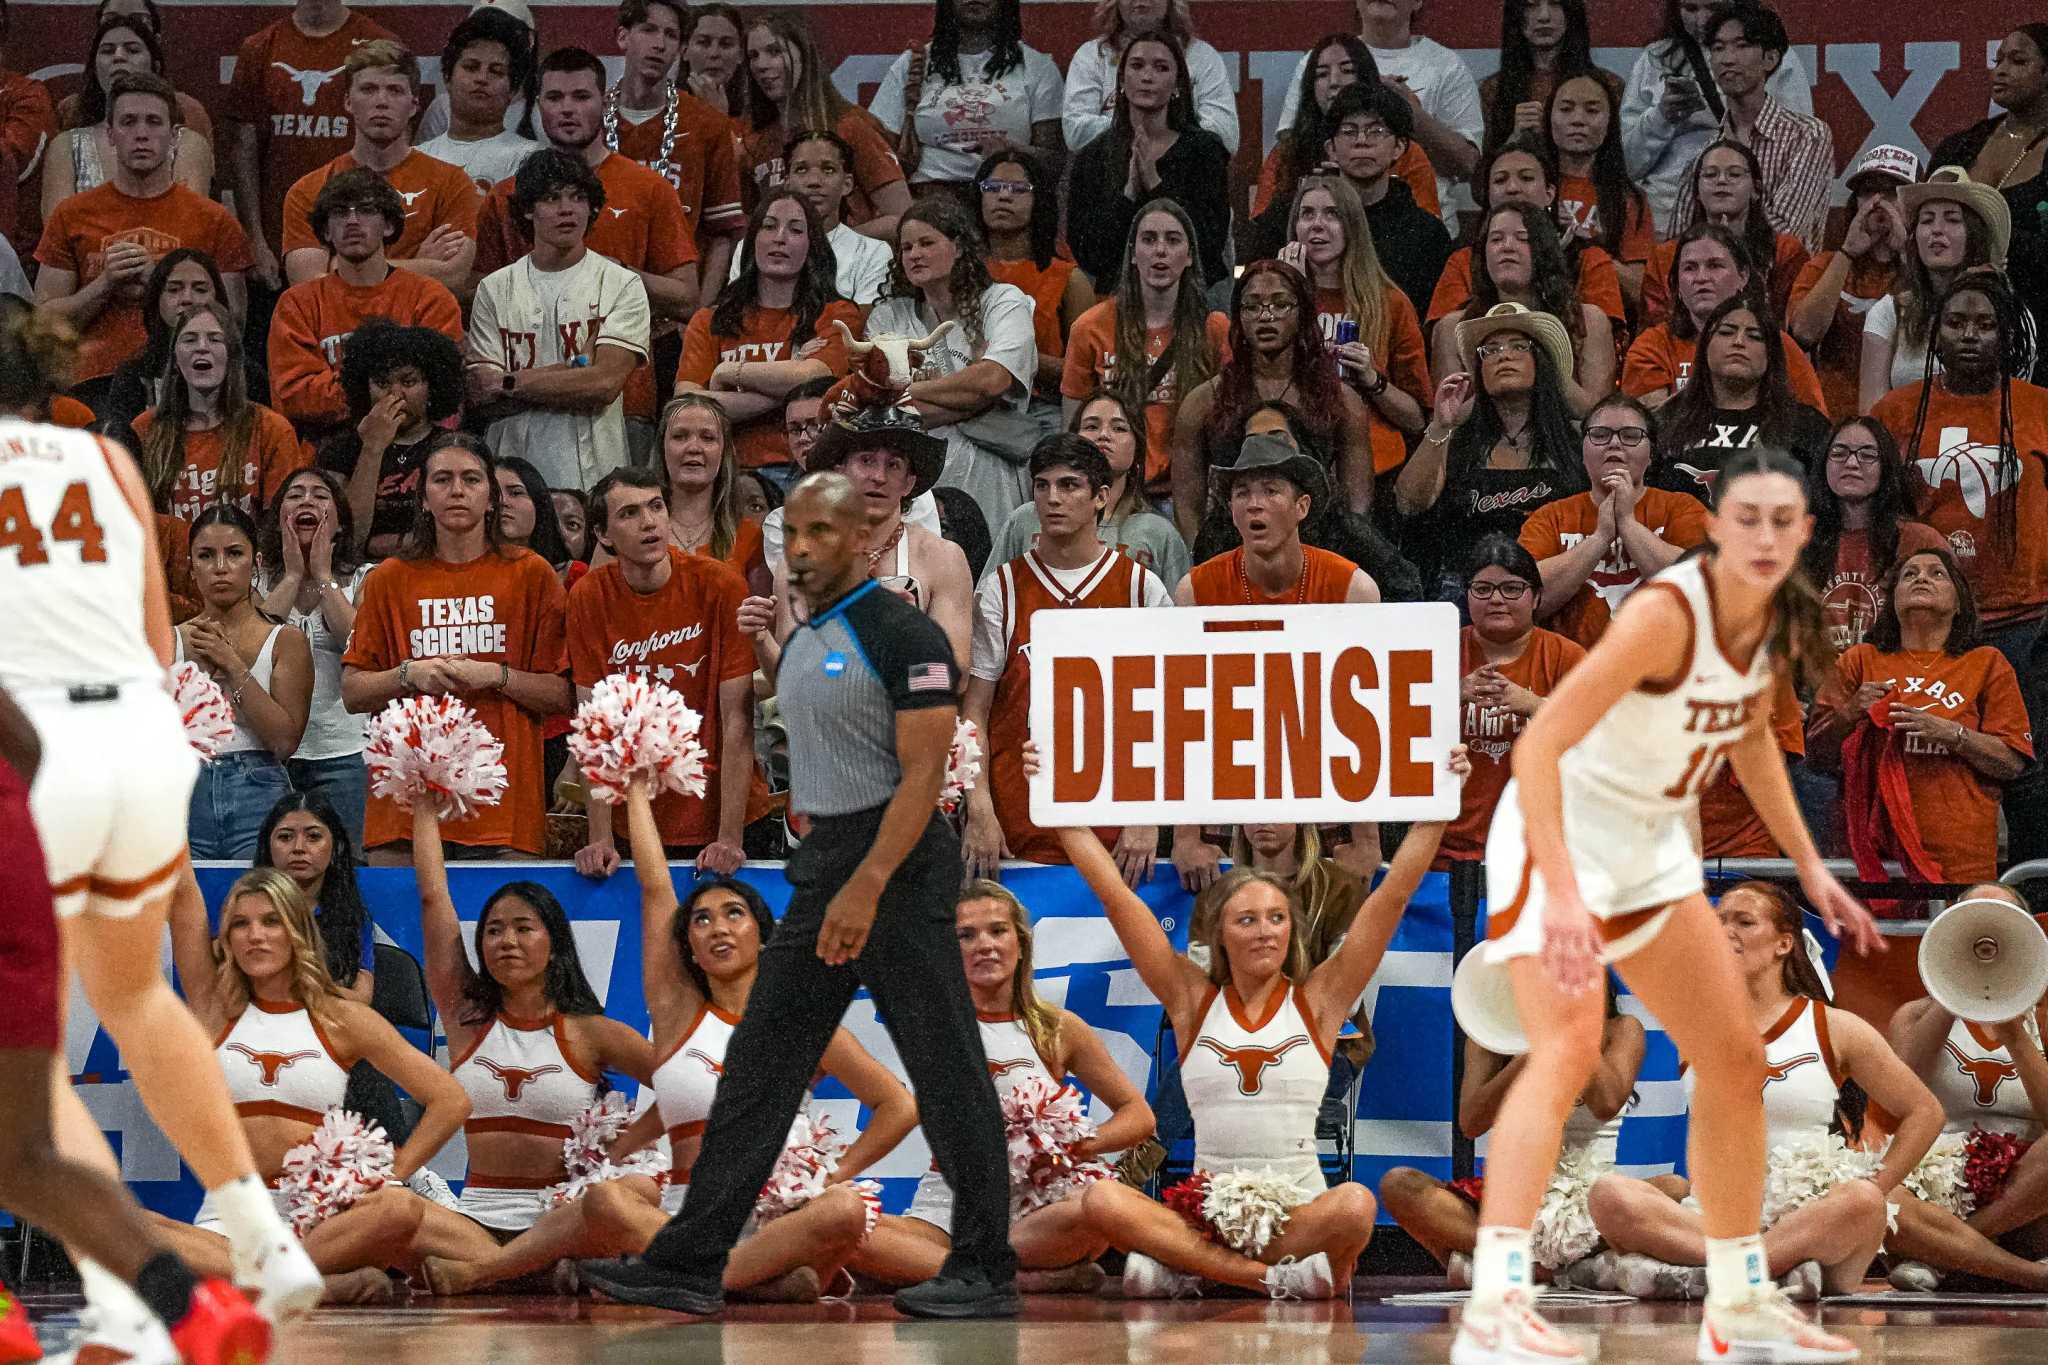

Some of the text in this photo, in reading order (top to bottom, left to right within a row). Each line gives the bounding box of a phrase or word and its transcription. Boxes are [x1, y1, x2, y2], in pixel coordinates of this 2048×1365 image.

[271, 114, 349, 137] TEXAS
[0, 479, 107, 567] 44
[418, 594, 495, 627] TEXAS
[410, 623, 507, 659] SCIENCE
[608, 622, 703, 664] Longhorns
[1053, 646, 1434, 803] DEFENSE
